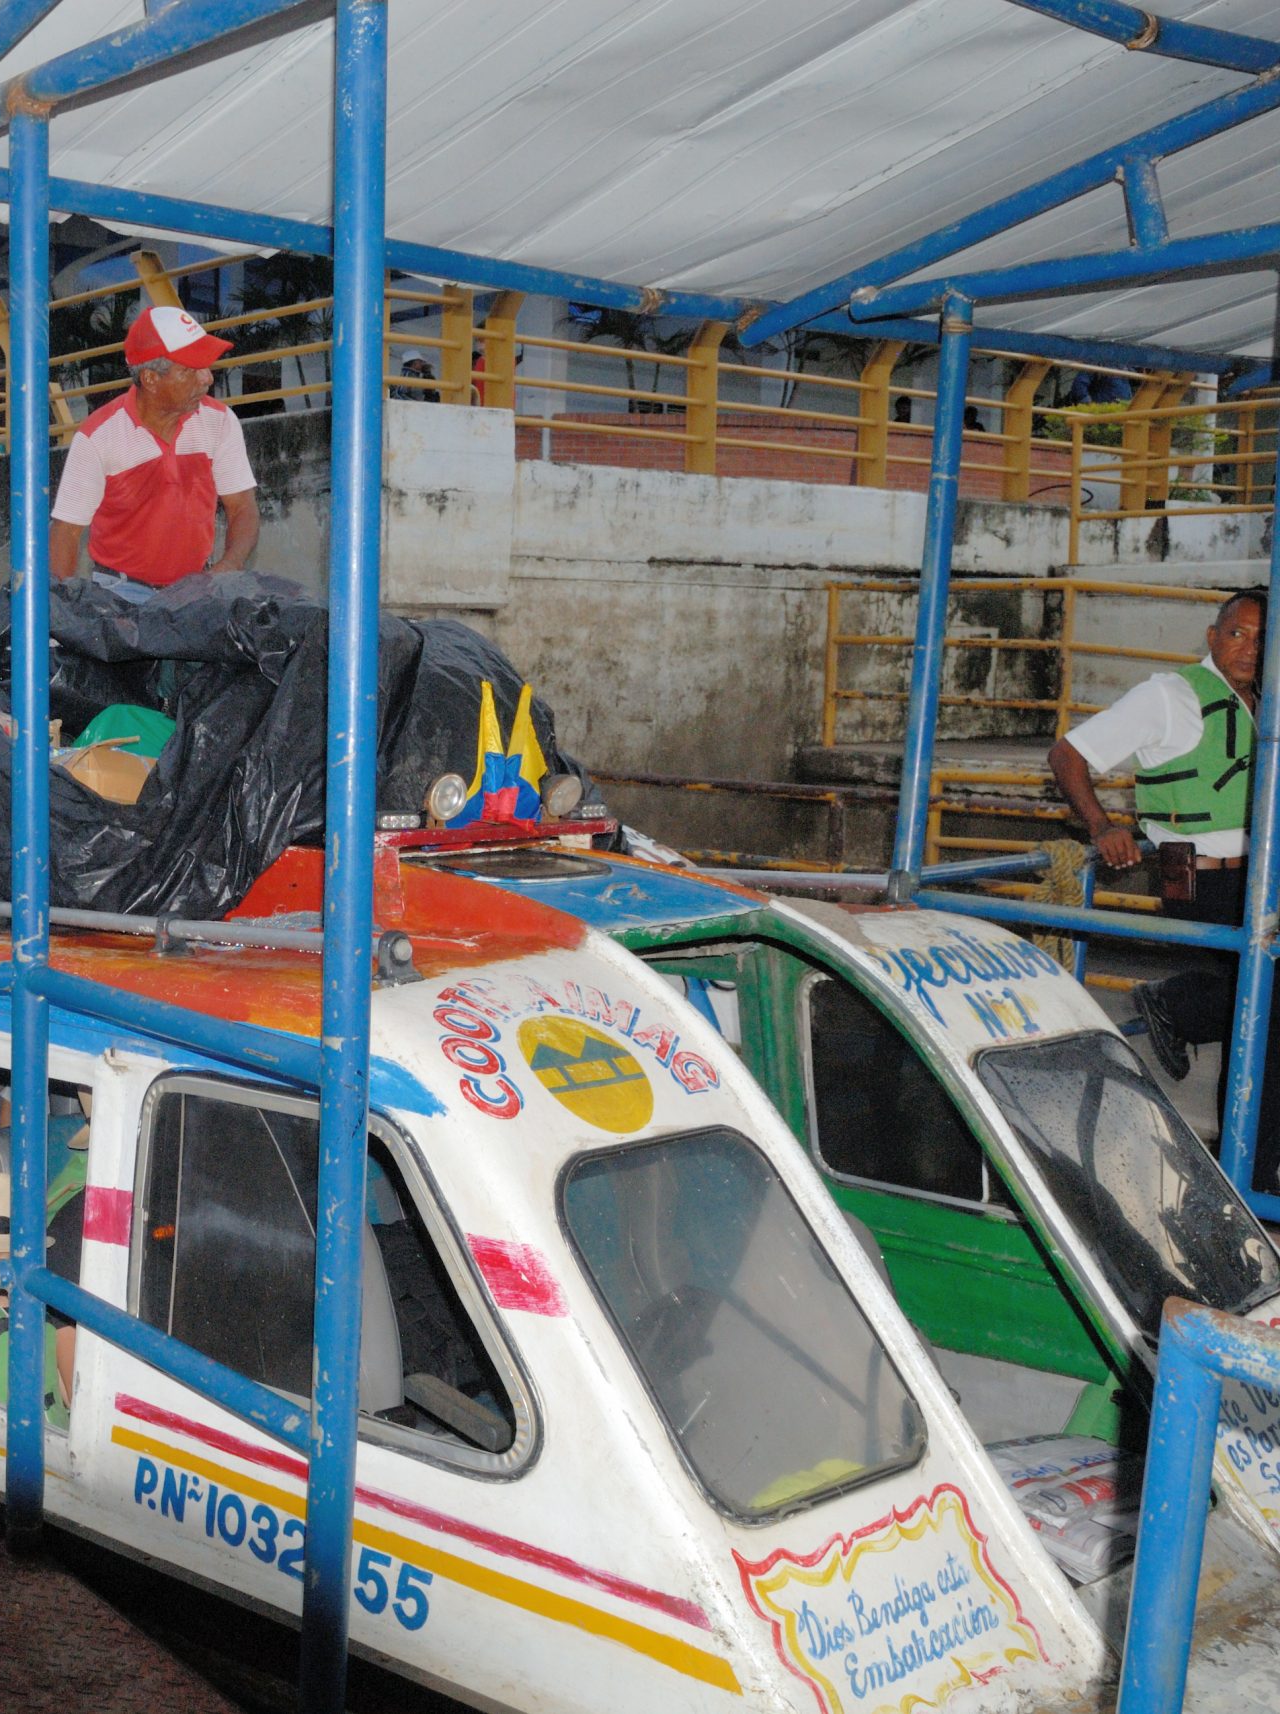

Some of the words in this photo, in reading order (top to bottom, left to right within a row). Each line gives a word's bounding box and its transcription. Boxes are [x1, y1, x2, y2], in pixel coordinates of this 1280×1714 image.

[1217, 1400, 1248, 1438] ste
[794, 1599, 856, 1660] Dios
[847, 1573, 936, 1637] Bendiga
